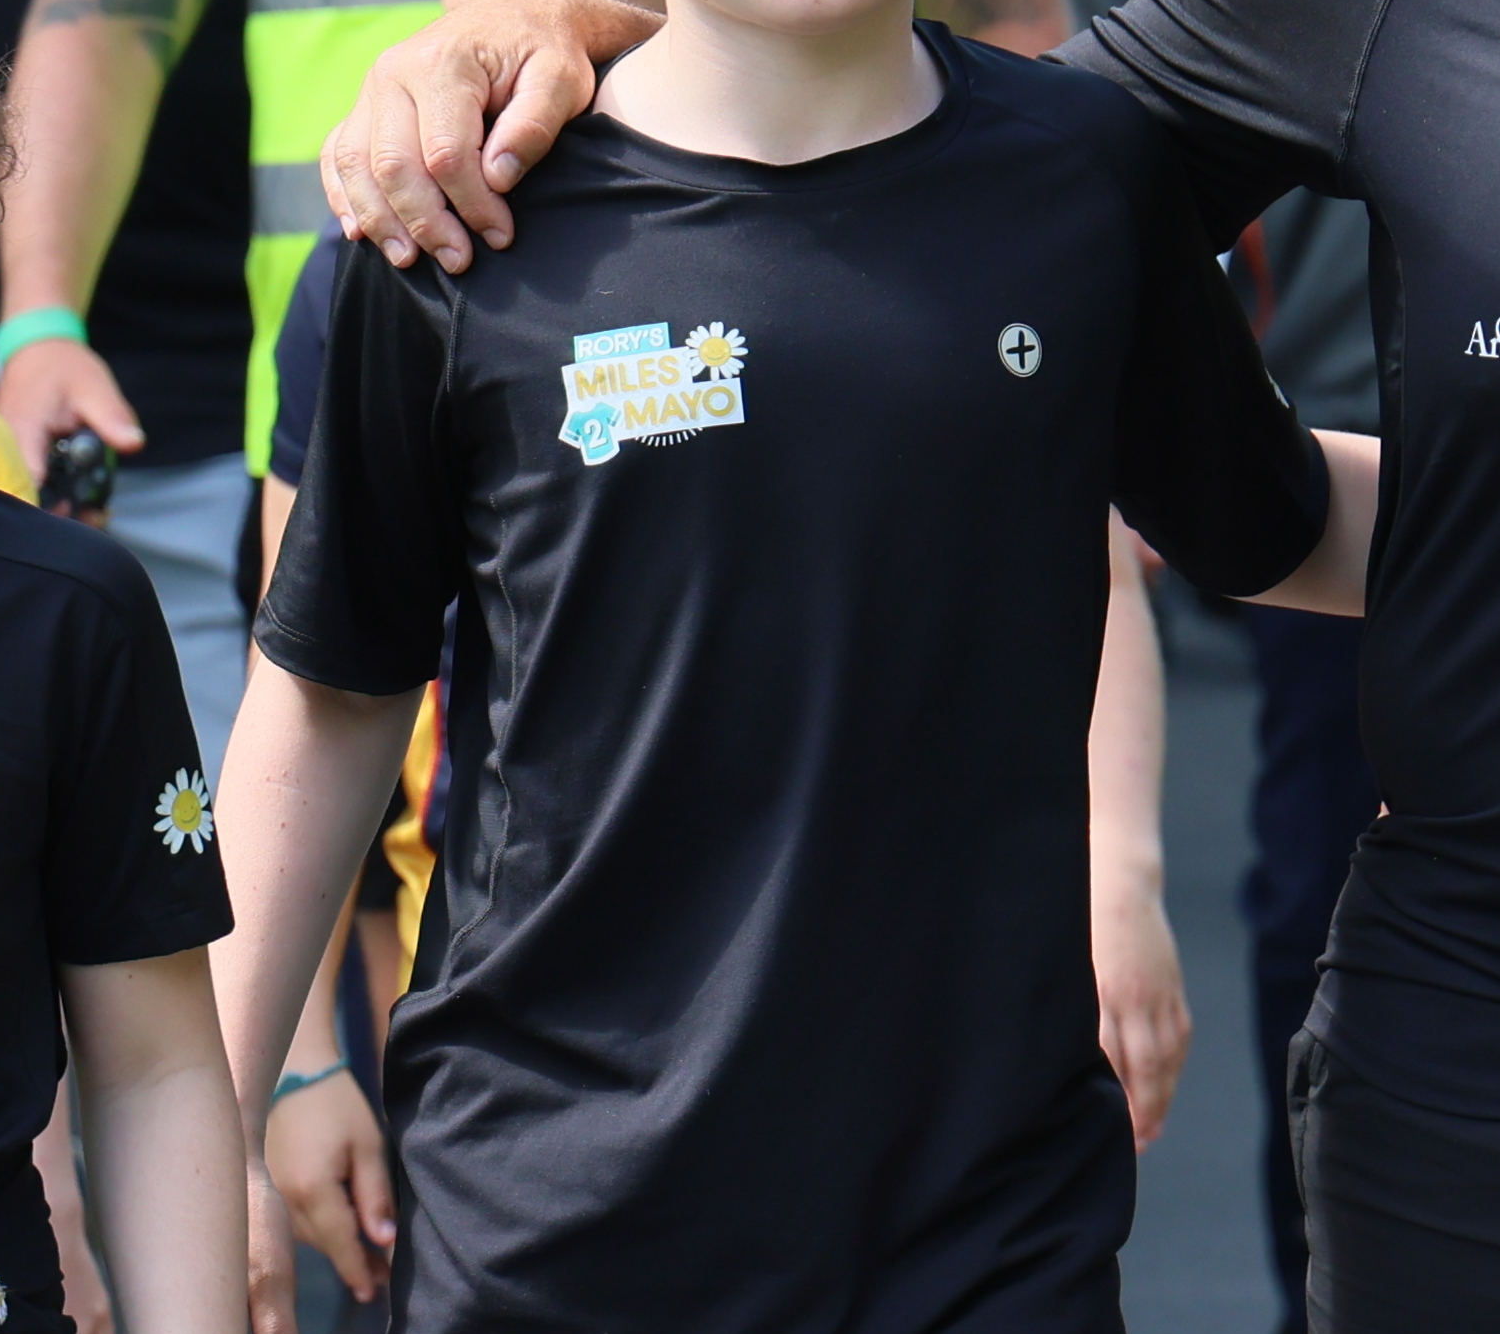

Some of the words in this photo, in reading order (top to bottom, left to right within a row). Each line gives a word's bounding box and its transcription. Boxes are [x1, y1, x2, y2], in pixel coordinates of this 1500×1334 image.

[578, 327, 664, 359] RORY'S
[574, 354, 680, 401] MILES
[583, 418, 608, 450] 2
[622, 385, 737, 430] MAYO
